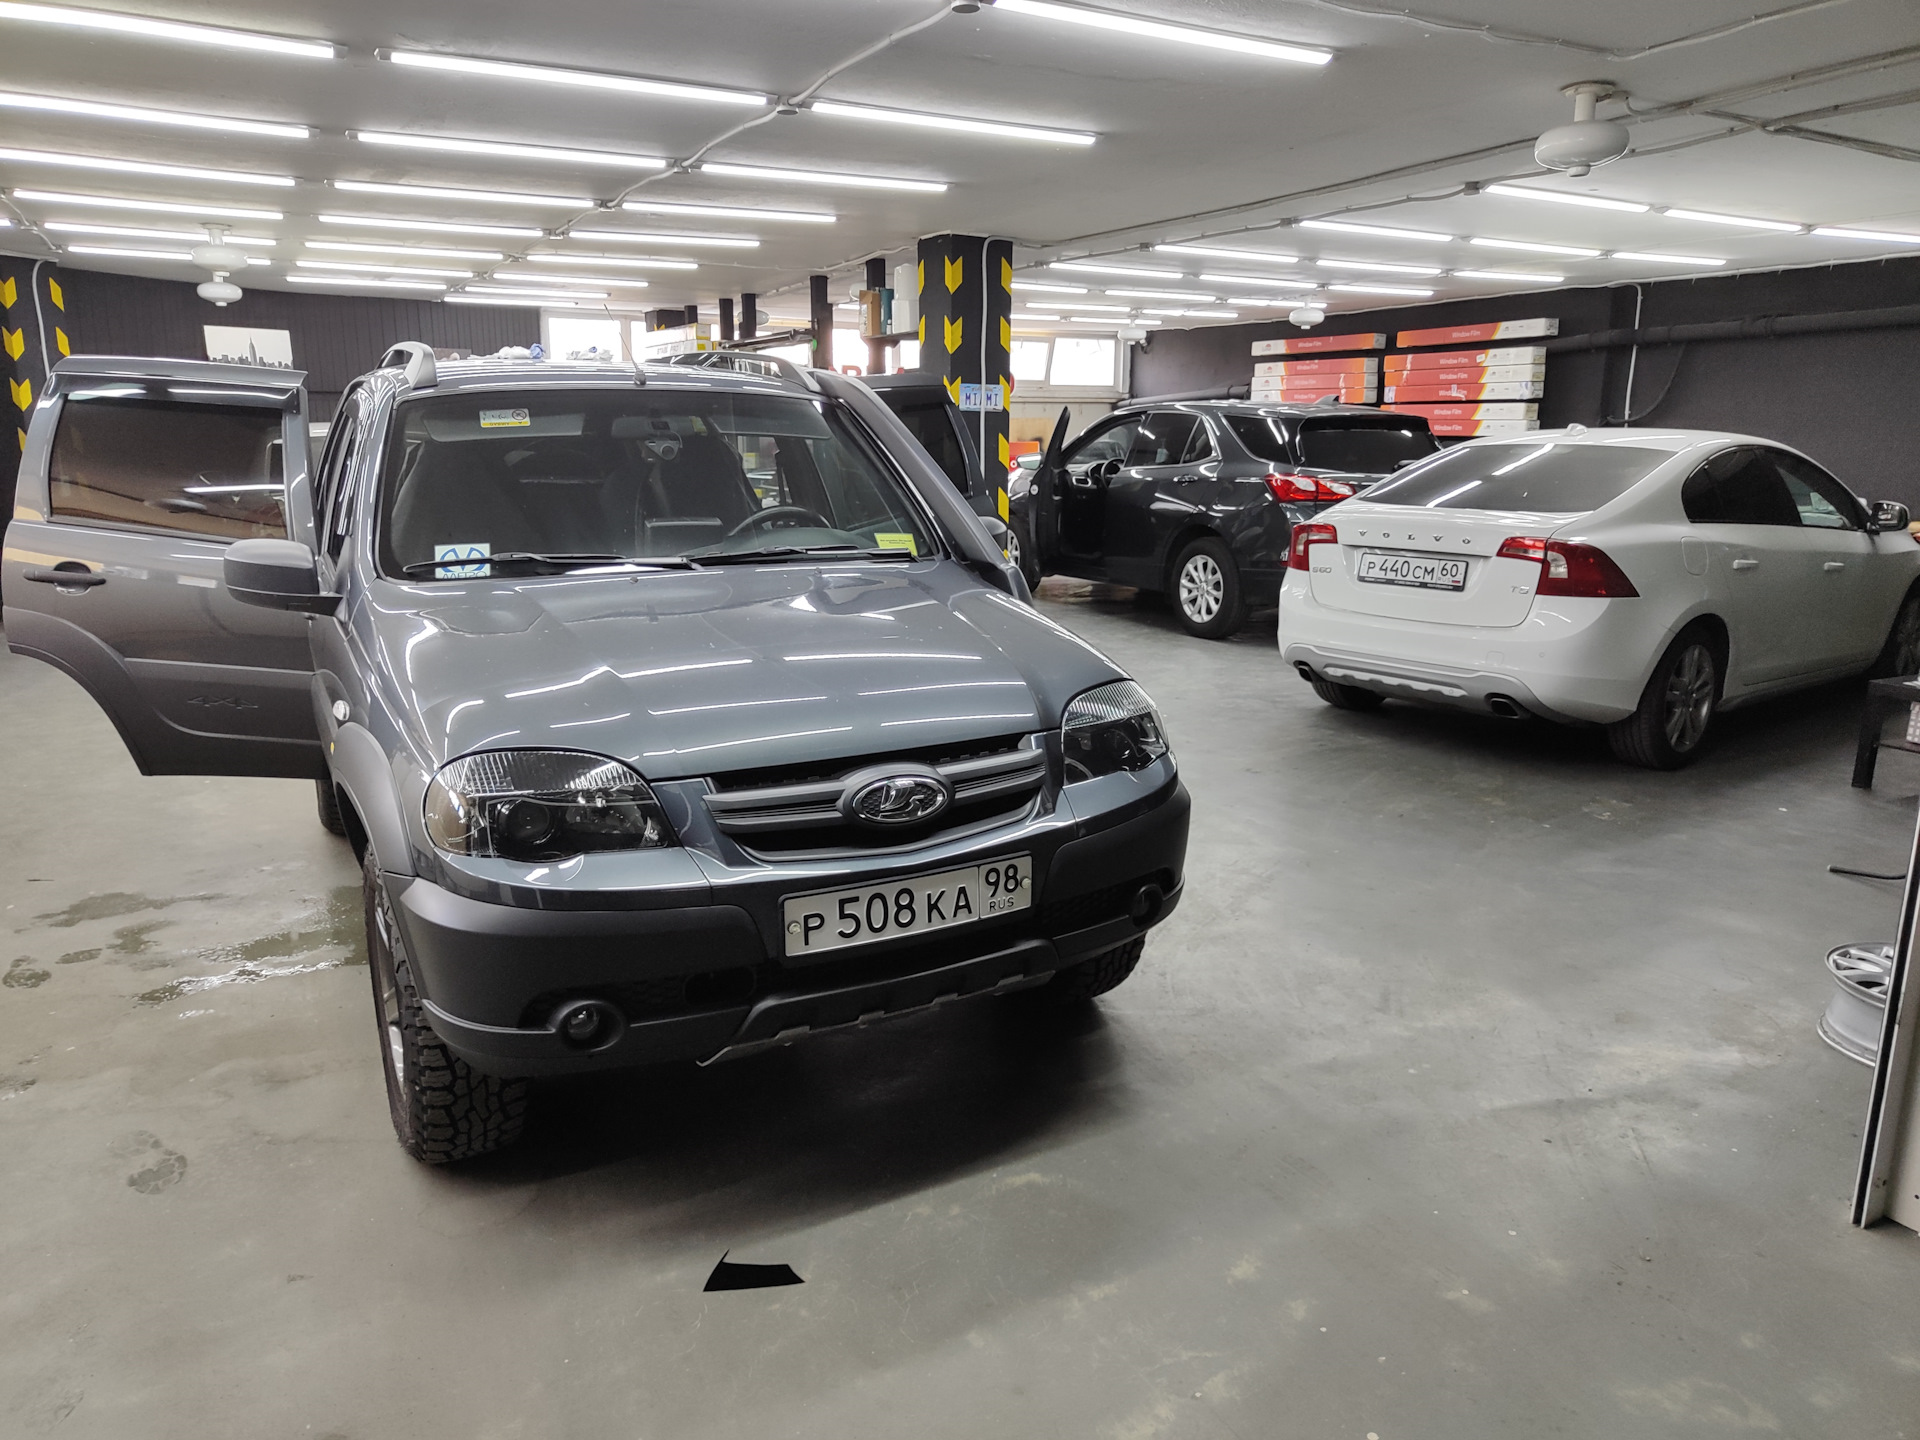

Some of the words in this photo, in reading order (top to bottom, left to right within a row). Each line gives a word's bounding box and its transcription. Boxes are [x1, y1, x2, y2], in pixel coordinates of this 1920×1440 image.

[1458, 356, 1469, 364] Film
[1457, 371, 1469, 379] Film
[965, 392, 999, 407] MIMI
[1433, 408, 1452, 416] Window
[1451, 407, 1463, 415] Film
[1433, 424, 1452, 432] Window
[1451, 423, 1463, 431] Film
[1357, 529, 1472, 545] VOLVO
[988, 895, 1015, 913] RUS
